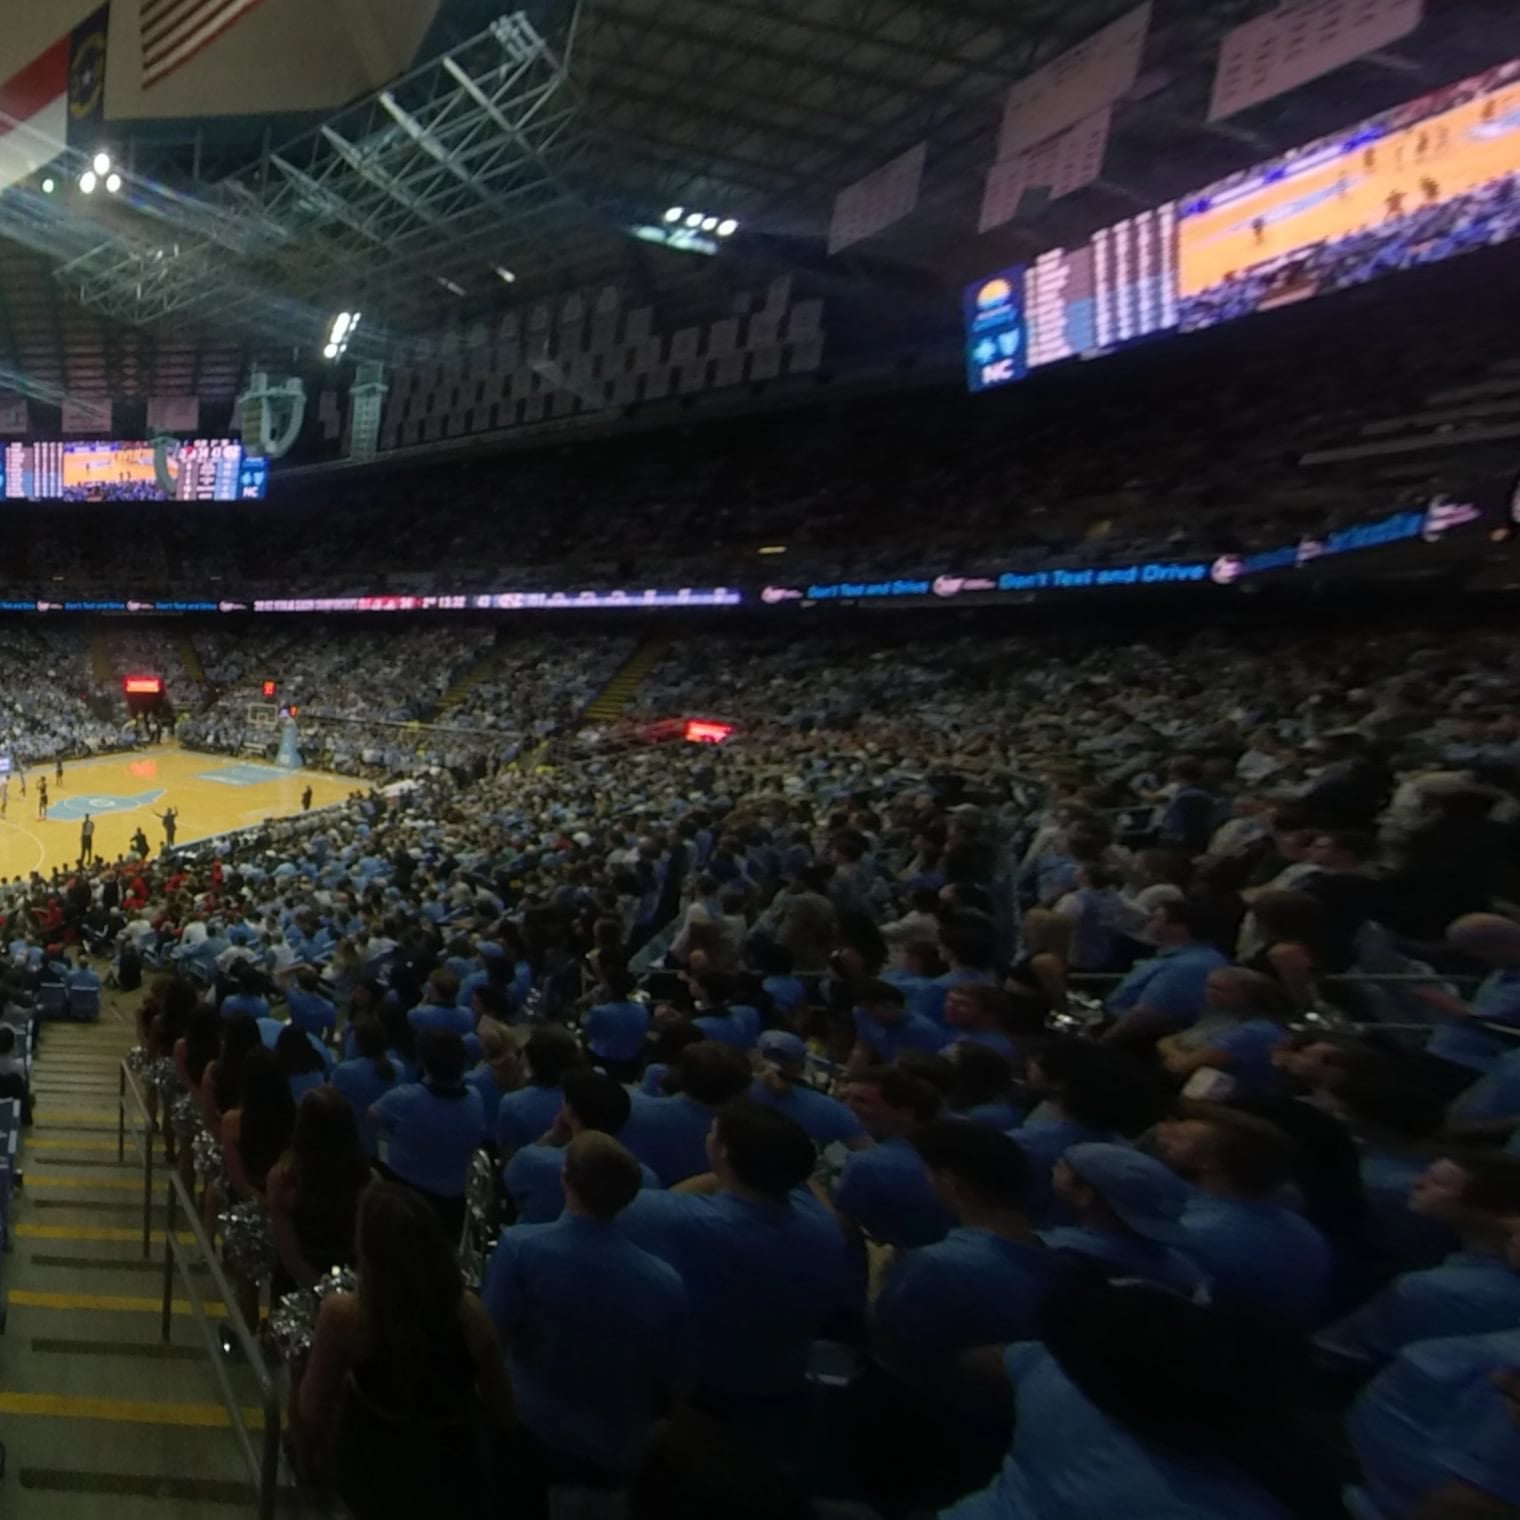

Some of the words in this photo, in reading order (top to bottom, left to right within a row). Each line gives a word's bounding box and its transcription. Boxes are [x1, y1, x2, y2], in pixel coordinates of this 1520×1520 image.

[998, 572, 1047, 589] Don't
[1052, 569, 1094, 587] Text
[1096, 566, 1137, 584] and
[1141, 564, 1206, 583] Drive
